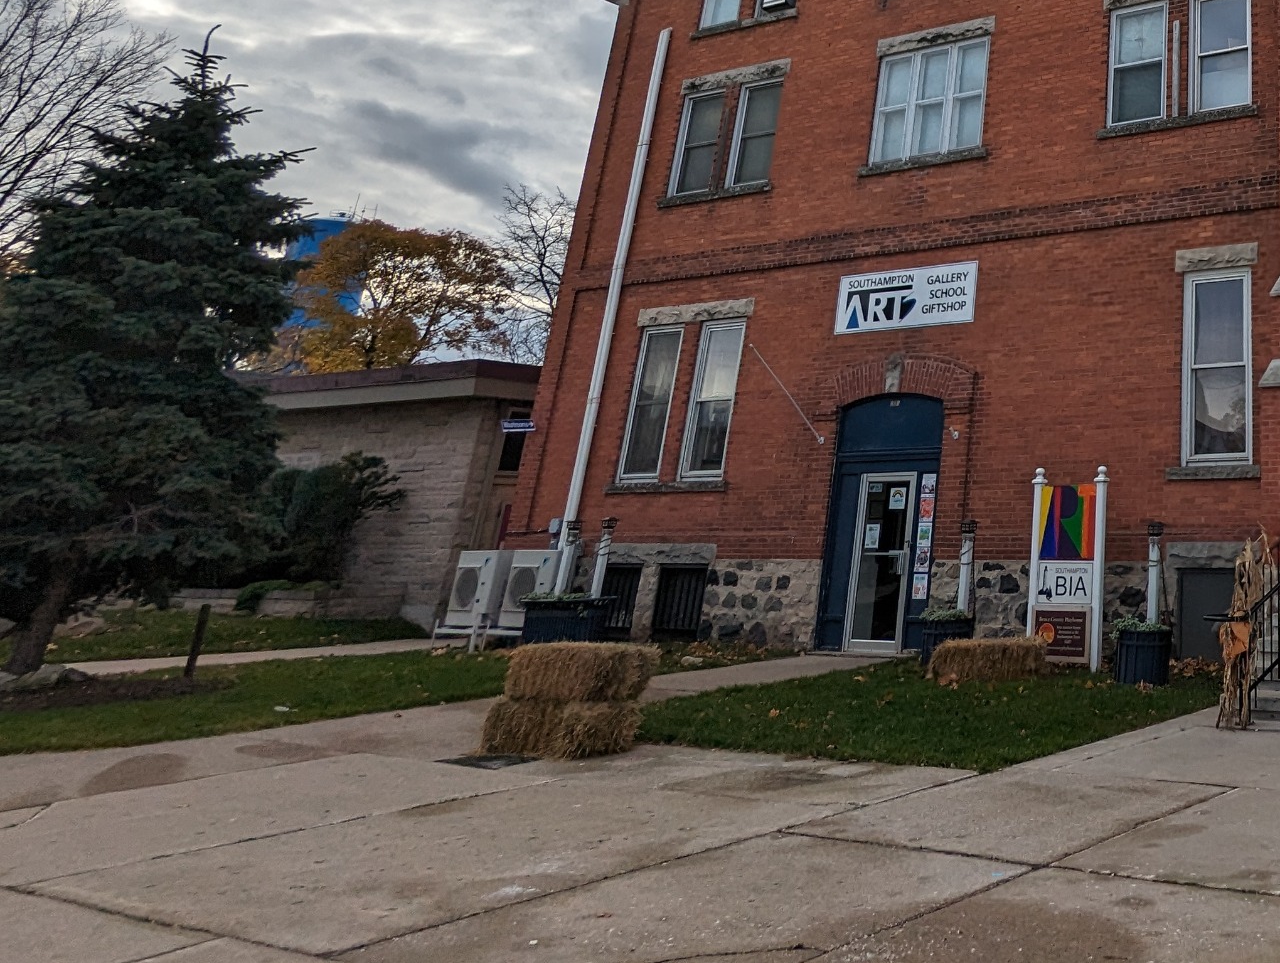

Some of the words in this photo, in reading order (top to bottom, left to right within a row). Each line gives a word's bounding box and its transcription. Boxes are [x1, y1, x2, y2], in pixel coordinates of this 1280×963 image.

[848, 274, 915, 290] SOUTHAMPTON
[926, 271, 970, 286] GALLERY
[929, 286, 968, 300] SCHOOL
[921, 301, 967, 315] GIFTSHOP
[1055, 575, 1087, 596] BIA
